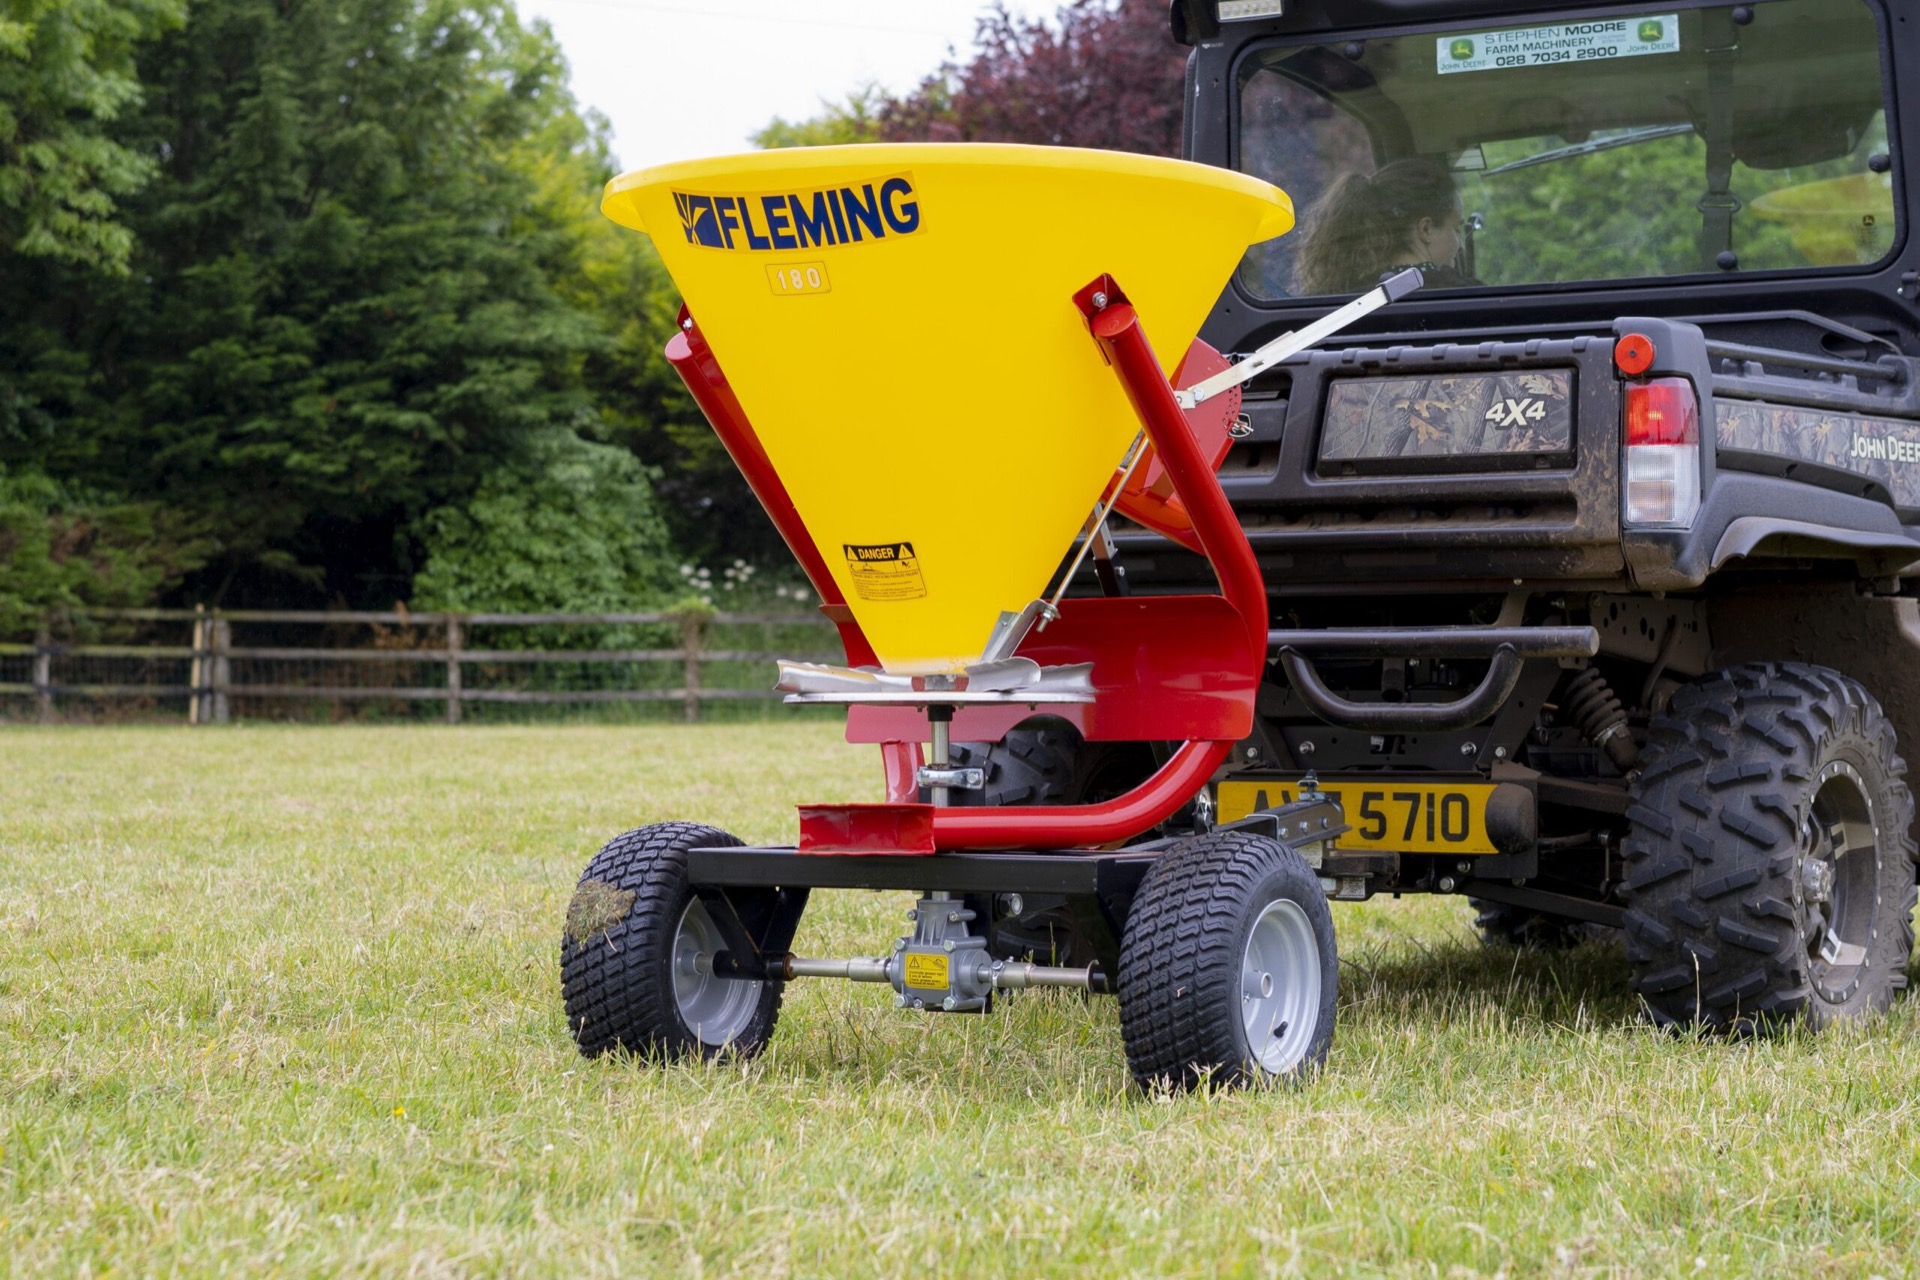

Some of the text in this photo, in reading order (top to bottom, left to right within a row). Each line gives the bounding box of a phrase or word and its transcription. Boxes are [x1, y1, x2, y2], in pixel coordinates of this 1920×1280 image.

[1484, 21, 1627, 44] STEPHEN MOORE
[1485, 44, 1520, 55] FARM
[1522, 36, 1594, 51] MACHINERY
[1495, 46, 1618, 67] 028 7034 2900
[713, 178, 920, 250] FLEMING
[776, 266, 822, 291] 180
[1484, 398, 1547, 427] 4X4
[1850, 431, 1886, 460] JOHN
[857, 547, 895, 560] DANGER
[1358, 791, 1470, 842] 5710
